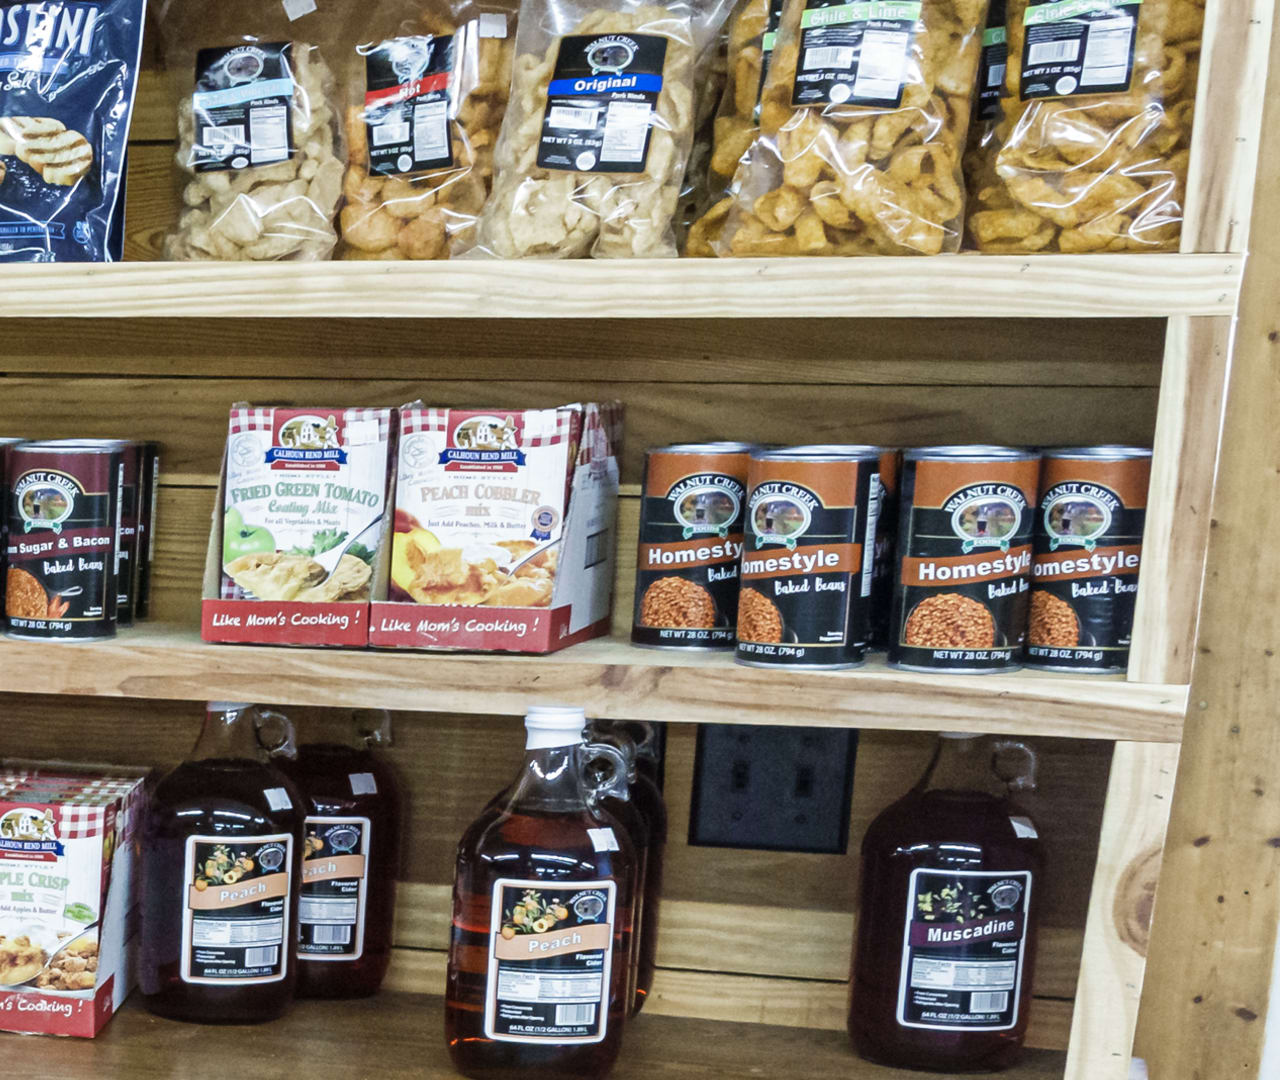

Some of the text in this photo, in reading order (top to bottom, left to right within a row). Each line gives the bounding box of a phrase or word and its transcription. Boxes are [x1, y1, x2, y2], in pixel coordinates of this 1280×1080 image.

[868, 4, 906, 20] Lime
[5, 71, 37, 90] Salt
[574, 76, 637, 92] Original
[399, 84, 421, 98] Hot
[273, 450, 340, 459] CALHOUN BEND MILL
[447, 450, 518, 460] CALHOUN BEND MILL
[48, 473, 81, 499] CREEK
[231, 482, 379, 508] FRIED GREEN TOMATO
[420, 483, 542, 506] PEACH COBBLER
[669, 475, 745, 502] WALNUT CREEK
[782, 483, 819, 512] CREEK
[945, 485, 1026, 513] WALNUT CREEK
[1080, 484, 1121, 513] CREEK
[268, 500, 340, 518] Coating Mix
[284, 518, 316, 527] Vegetables
[428, 519, 527, 530] Just Add Milk Butter
[20, 536, 110, 554] Sugar Bacon
[44, 557, 104, 575] Baked Beans
[919, 550, 1032, 581] Homestyle
[708, 567, 738, 583] Baked
[774, 577, 846, 596] Baked Beans
[988, 580, 1016, 599] Baked
[1072, 581, 1108, 598] Baked
[212, 612, 349, 630] Like Mom's Cooking
[380, 617, 527, 638] Like Mom's Cooking
[660, 630, 710, 639] NET WT 28 OZ.
[778, 646, 795, 656] (794
[933, 650, 989, 660] NET WT 28 OZ.
[23, 841, 41, 850] BEND
[41, 842, 57, 851] MILL
[28, 871, 71, 892] CRISP
[331, 880, 358, 888] Flavored
[11, 888, 35, 903] mix
[219, 882, 266, 902] Peach
[0, 904, 12, 912] Add
[927, 919, 1016, 942] Muscadine
[528, 932, 582, 953] Peach
[575, 953, 603, 961] Flavored
[586, 959, 603, 967] Cider
[17, 998, 72, 1017] Cooking
